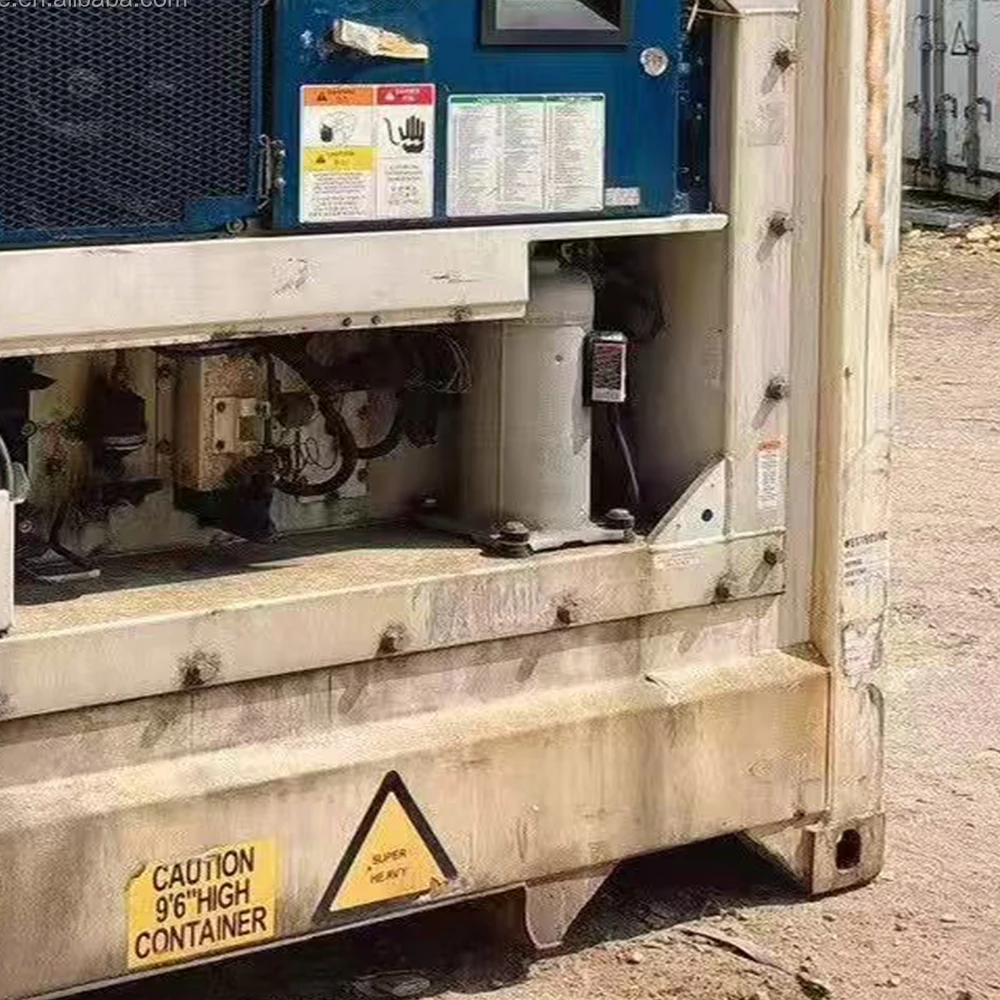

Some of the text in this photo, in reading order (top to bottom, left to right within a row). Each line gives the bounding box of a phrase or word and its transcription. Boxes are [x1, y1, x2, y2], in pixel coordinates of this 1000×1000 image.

[152, 846, 255, 892] CAUTION
[372, 848, 407, 865] SUPER
[370, 867, 406, 884] HEAVY
[134, 906, 268, 960] CONTAINER
